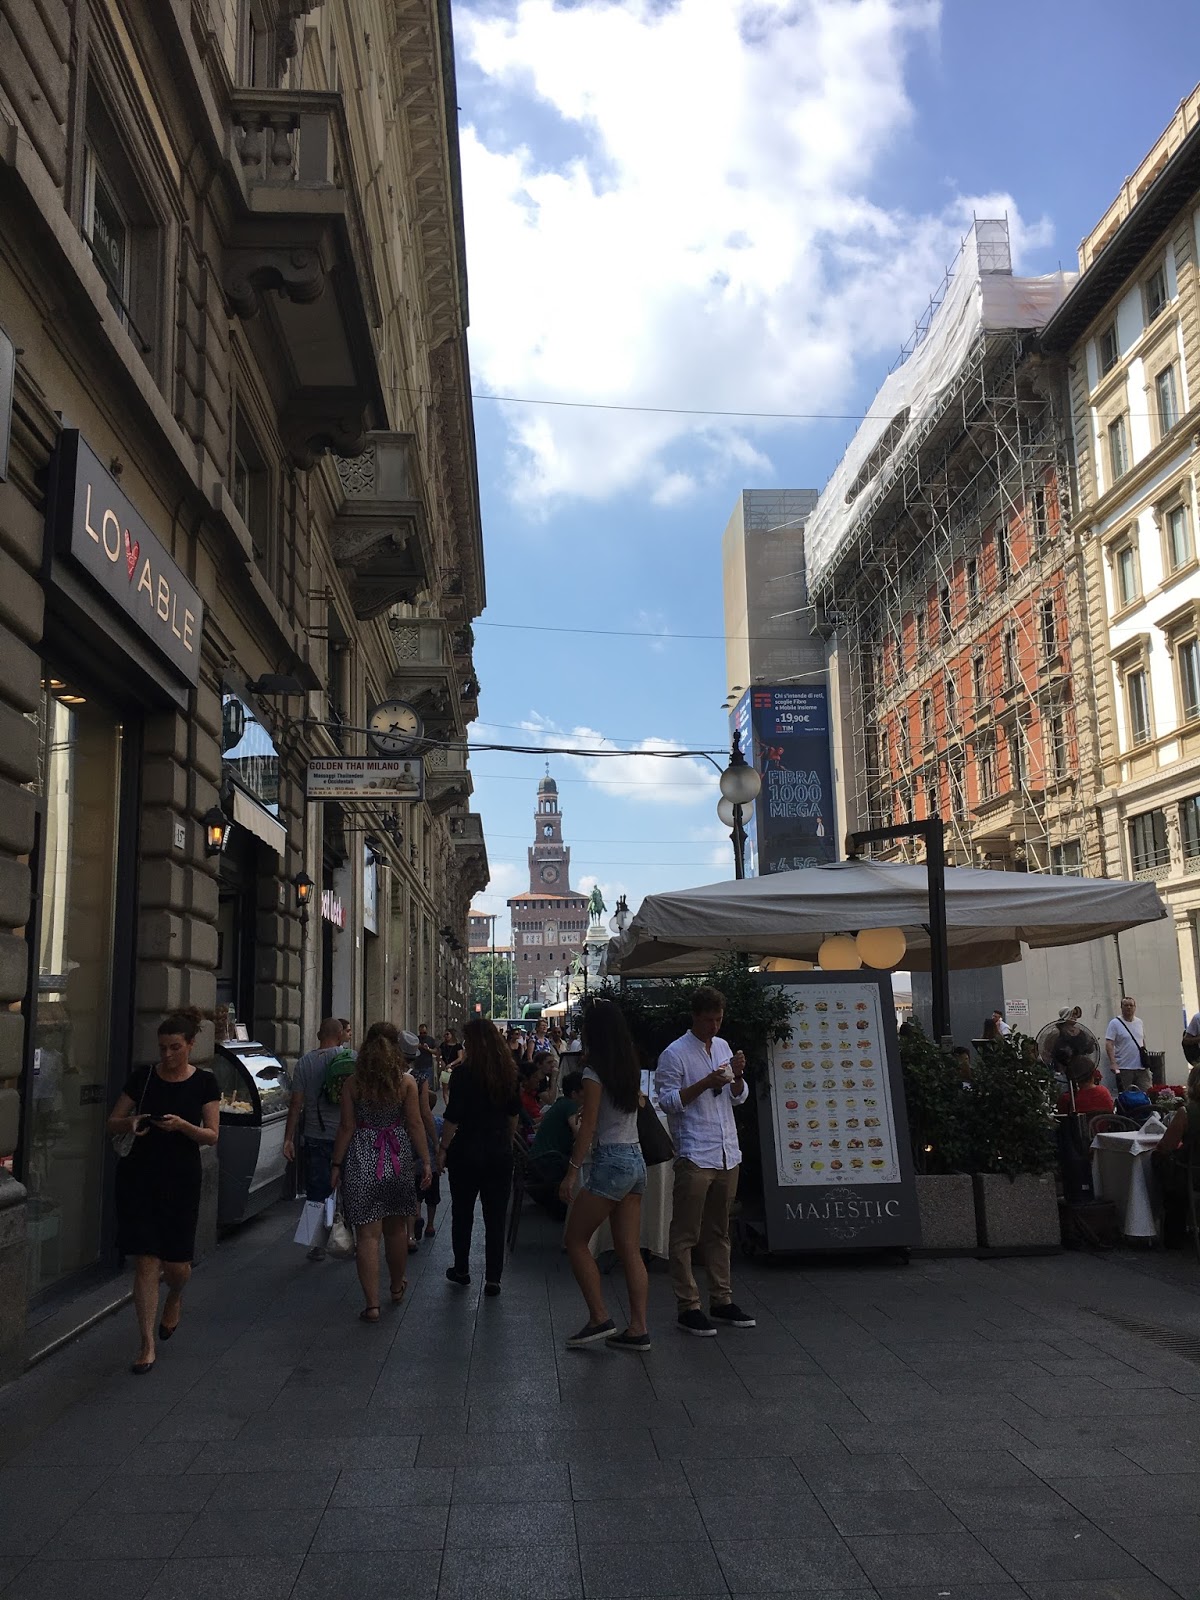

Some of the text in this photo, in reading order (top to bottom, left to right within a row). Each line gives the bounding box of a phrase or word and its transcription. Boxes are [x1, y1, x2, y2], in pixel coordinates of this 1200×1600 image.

[780, 713, 810, 724] 19,90€
[310, 762, 400, 771] GOLDEN THAI MILANO
[768, 770, 822, 784] FIBRA
[768, 784, 822, 802] 1000
[770, 802, 823, 818] MEGA
[778, 857, 818, 872] 45G
[785, 1199, 901, 1220] MAJESTIC
